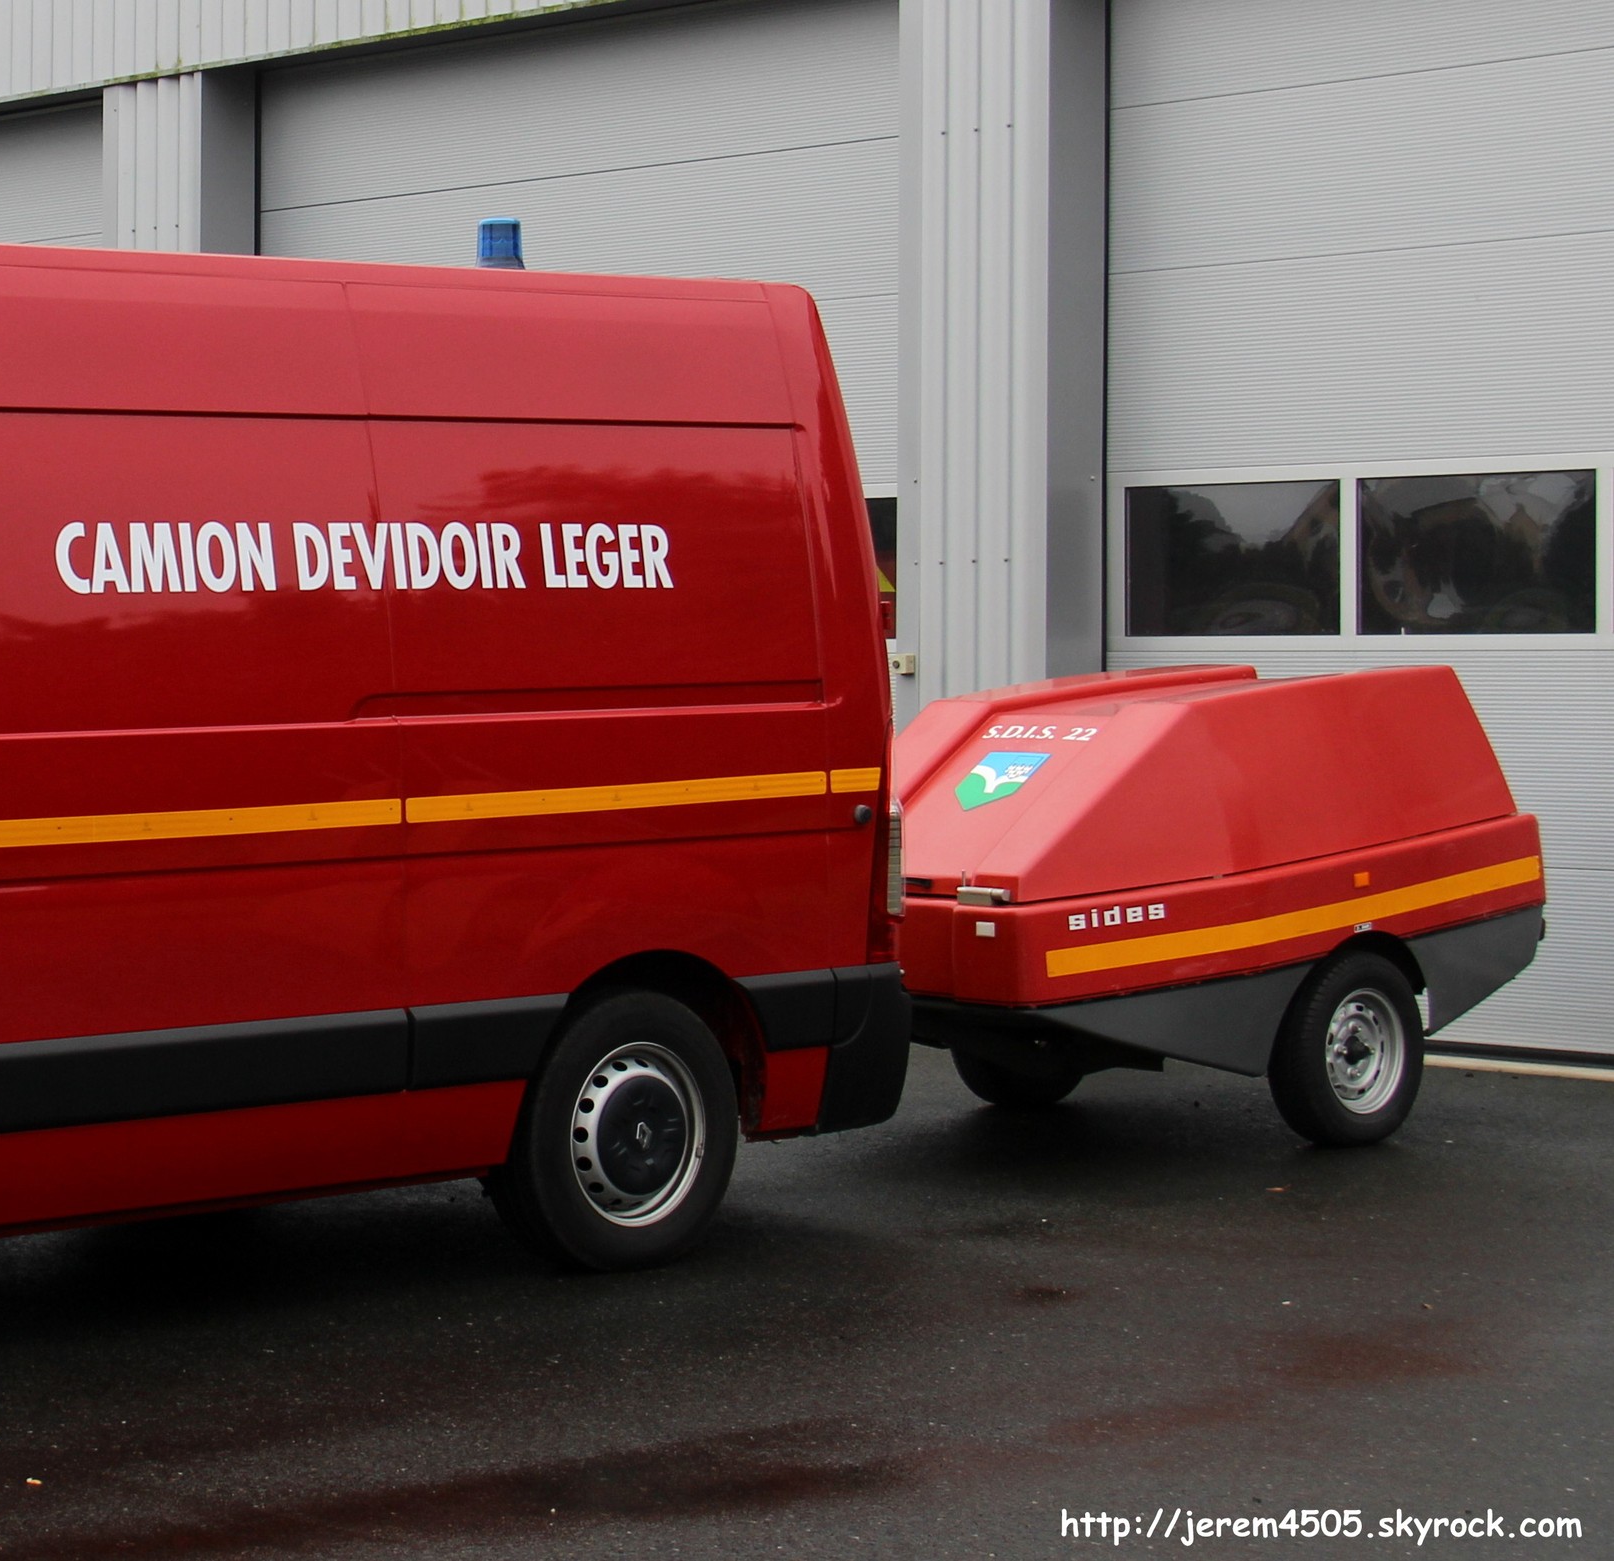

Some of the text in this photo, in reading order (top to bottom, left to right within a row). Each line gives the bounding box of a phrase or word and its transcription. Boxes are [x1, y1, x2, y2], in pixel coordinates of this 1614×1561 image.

[54, 521, 675, 594] CAMION DEVIDOIR LEGER
[981, 725, 1098, 742] S.D.I.S. 22
[1068, 903, 1166, 931] sides
